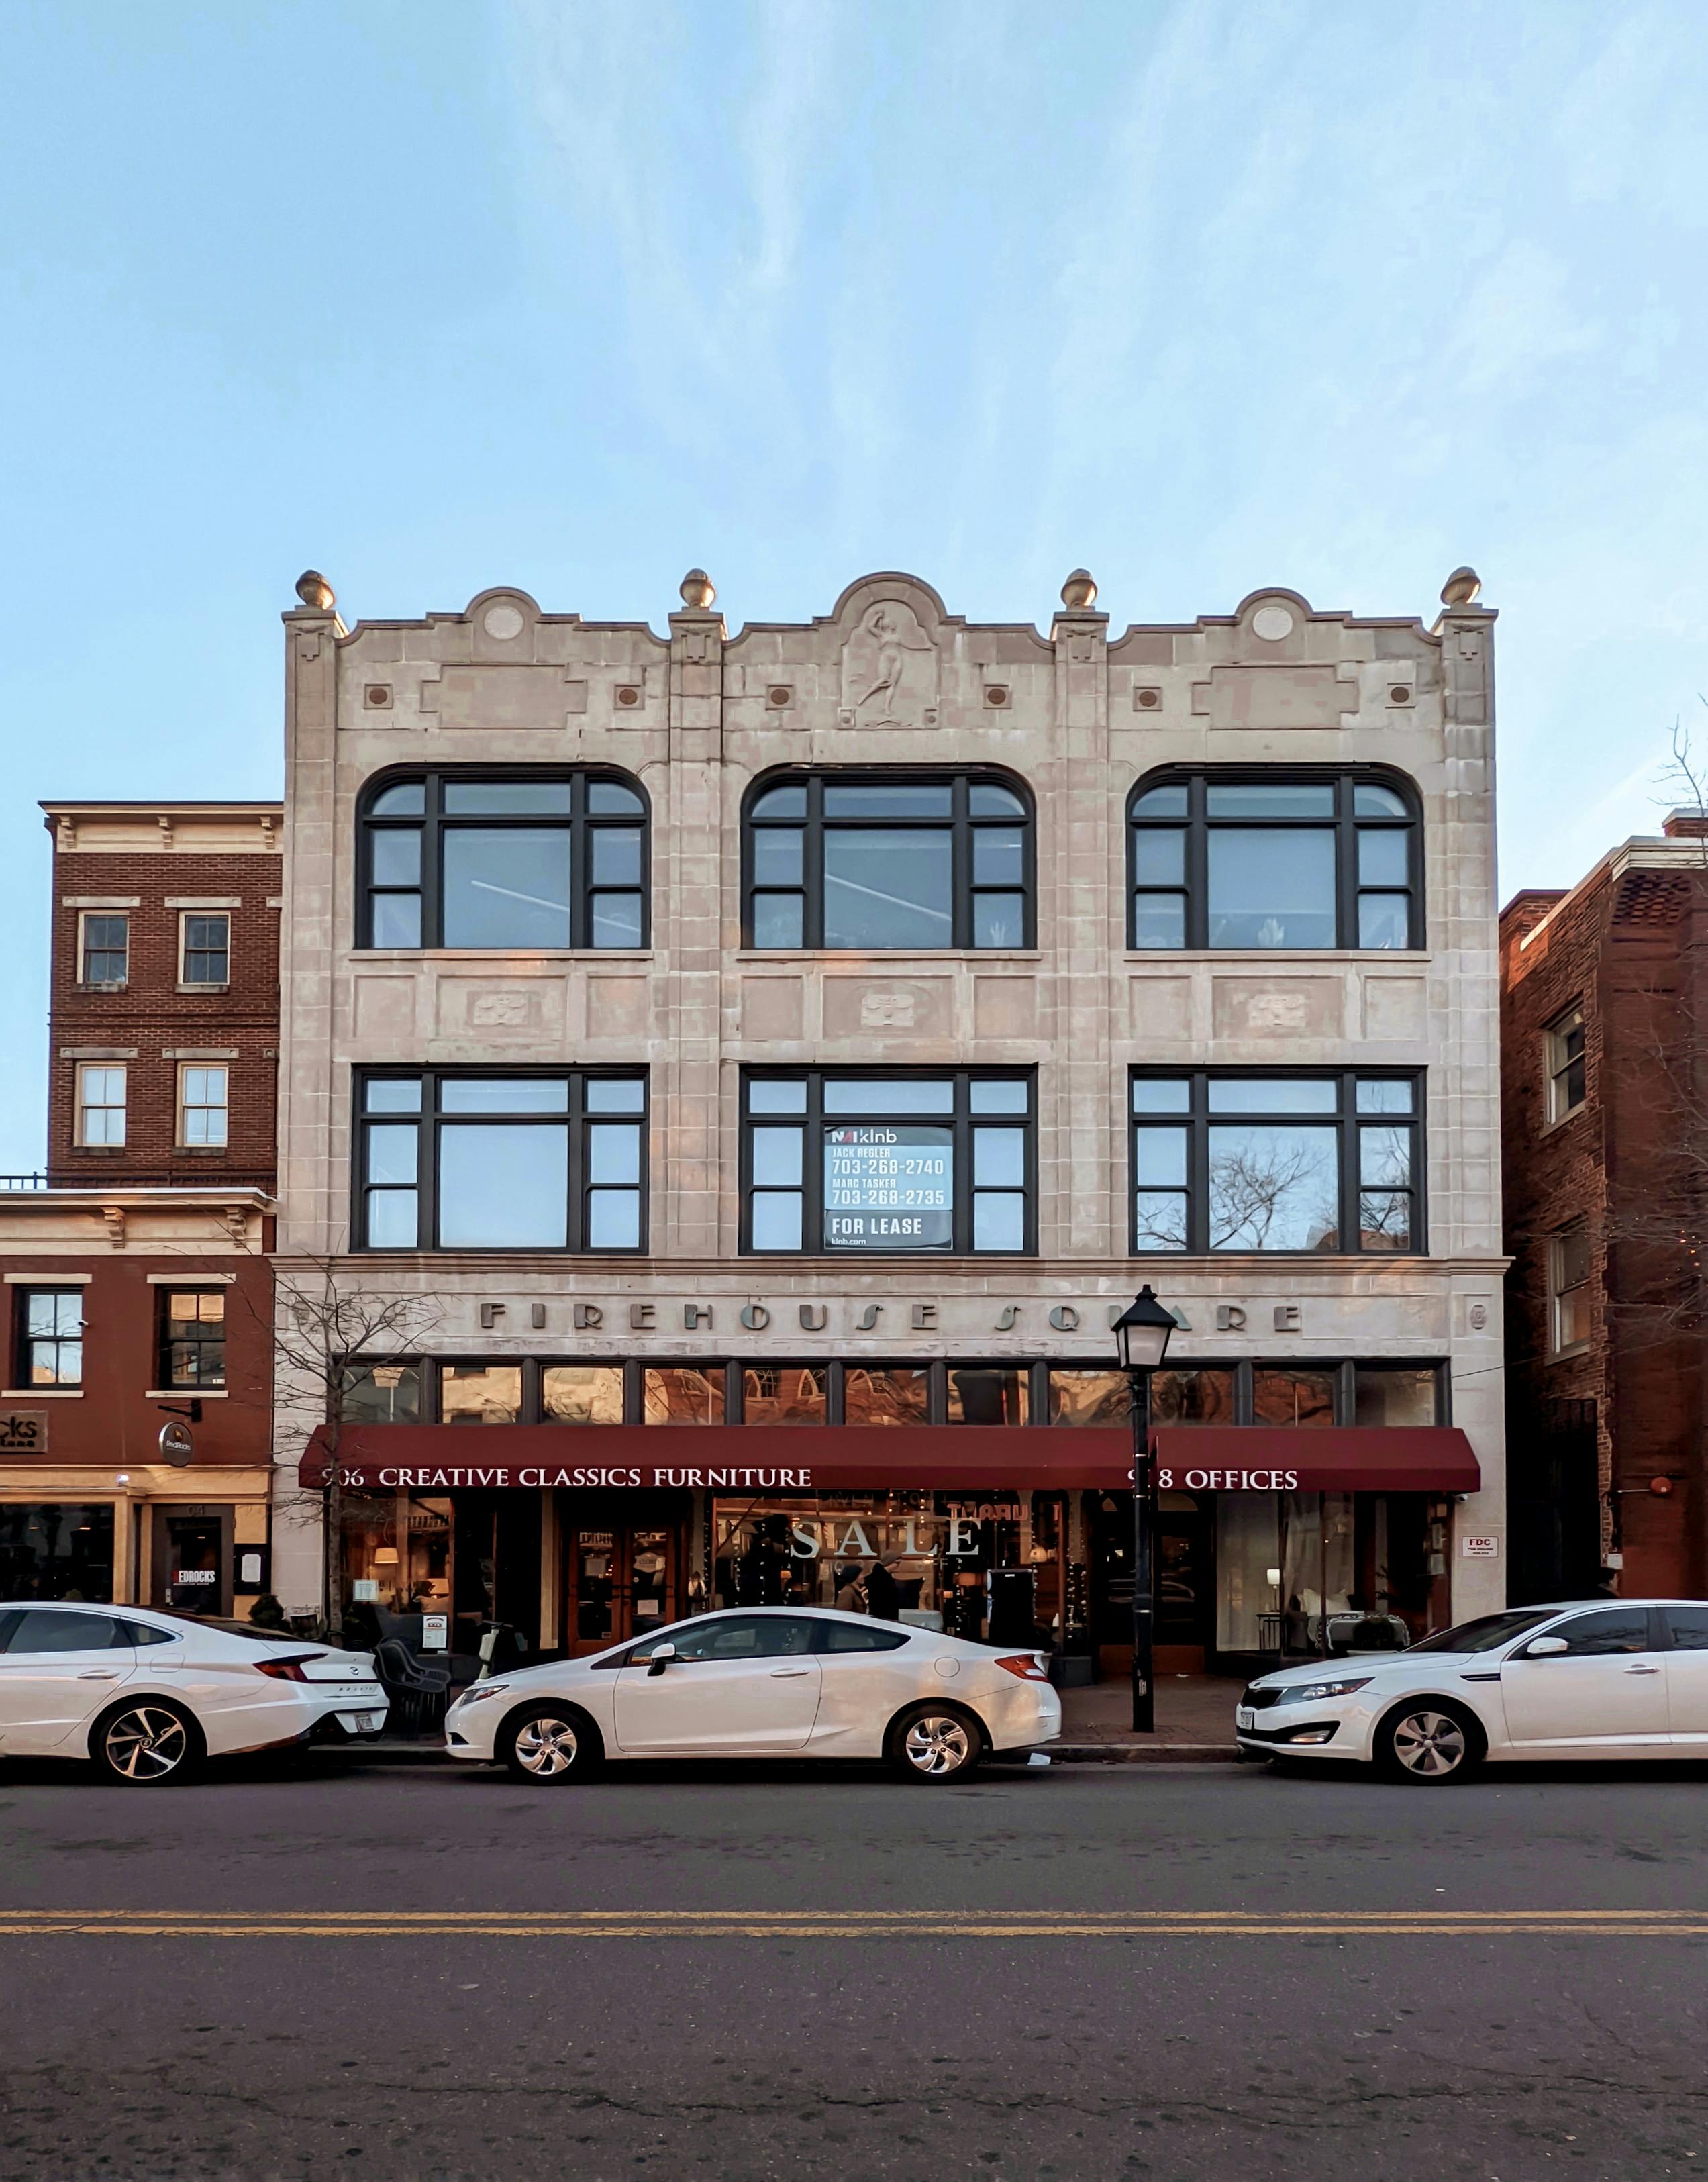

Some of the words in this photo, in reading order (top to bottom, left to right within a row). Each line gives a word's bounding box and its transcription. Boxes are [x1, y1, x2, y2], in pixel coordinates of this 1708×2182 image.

[832, 1148, 854, 1158] JACK
[832, 1159, 944, 1175] 703-268-2740
[832, 1179, 859, 1189] MARC
[862, 1179, 897, 1189] TASKER
[832, 1190, 944, 1205] 703-268-2735
[832, 1218, 864, 1235] FOR
[870, 1218, 922, 1235] LEASE
[480, 1303, 938, 1330] FIREHOUSE
[379, 1468, 509, 1487] CREATIVE
[519, 1468, 641, 1487] CLASSICS
[653, 1468, 813, 1487] FURNITURE
[1185, 1469, 1298, 1489] OFFICES
[789, 1517, 982, 1558] SALE
[172, 1570, 215, 1583] EDROCKS
